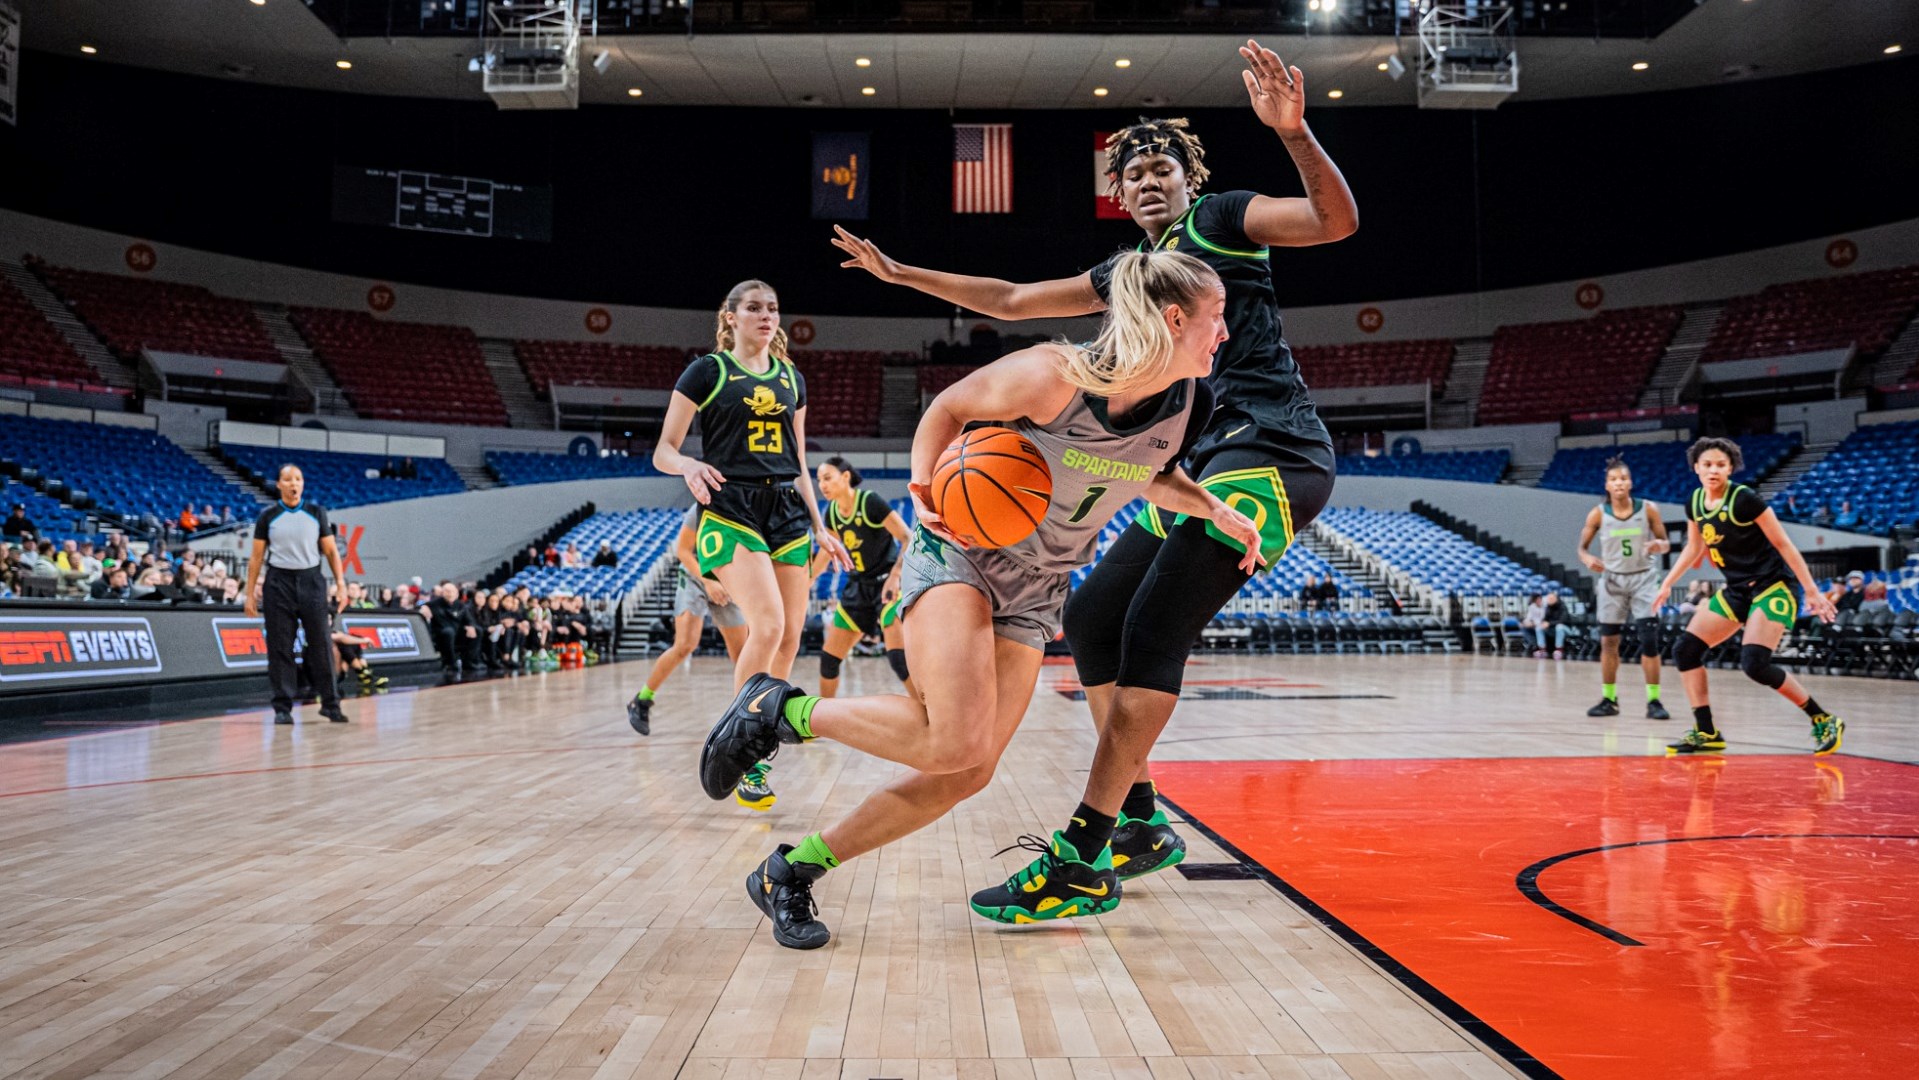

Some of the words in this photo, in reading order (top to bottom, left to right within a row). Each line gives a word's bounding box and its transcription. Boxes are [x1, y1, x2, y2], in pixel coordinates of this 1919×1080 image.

[373, 292, 390, 305] 57
[1362, 313, 1379, 327] 62
[748, 420, 783, 454] 23
[1061, 448, 1152, 482] SPARTANS
[1067, 485, 1110, 523] 1
[701, 531, 723, 558] O
[1621, 539, 1632, 557] 5
[1709, 548, 1725, 567] 4
[1768, 597, 1789, 616] O
[0, 631, 72, 665] ESPN
[69, 630, 153, 662] EVENTS
